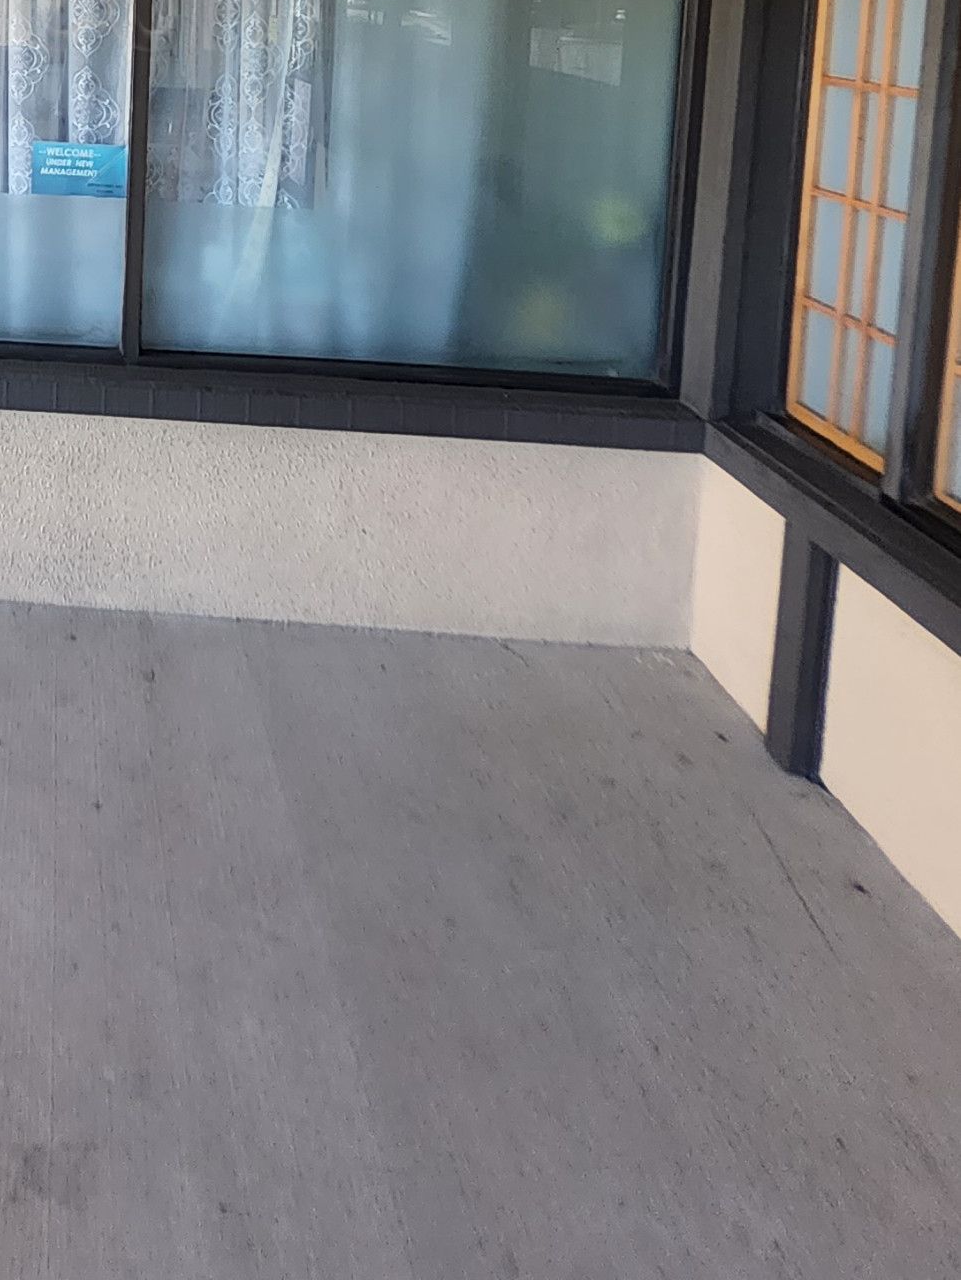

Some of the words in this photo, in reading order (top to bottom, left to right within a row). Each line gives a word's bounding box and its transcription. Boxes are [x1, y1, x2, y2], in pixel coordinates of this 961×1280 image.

[45, 158, 72, 166] UNDER
[75, 159, 95, 168] NEW
[40, 167, 98, 178] MANAGEMENT
